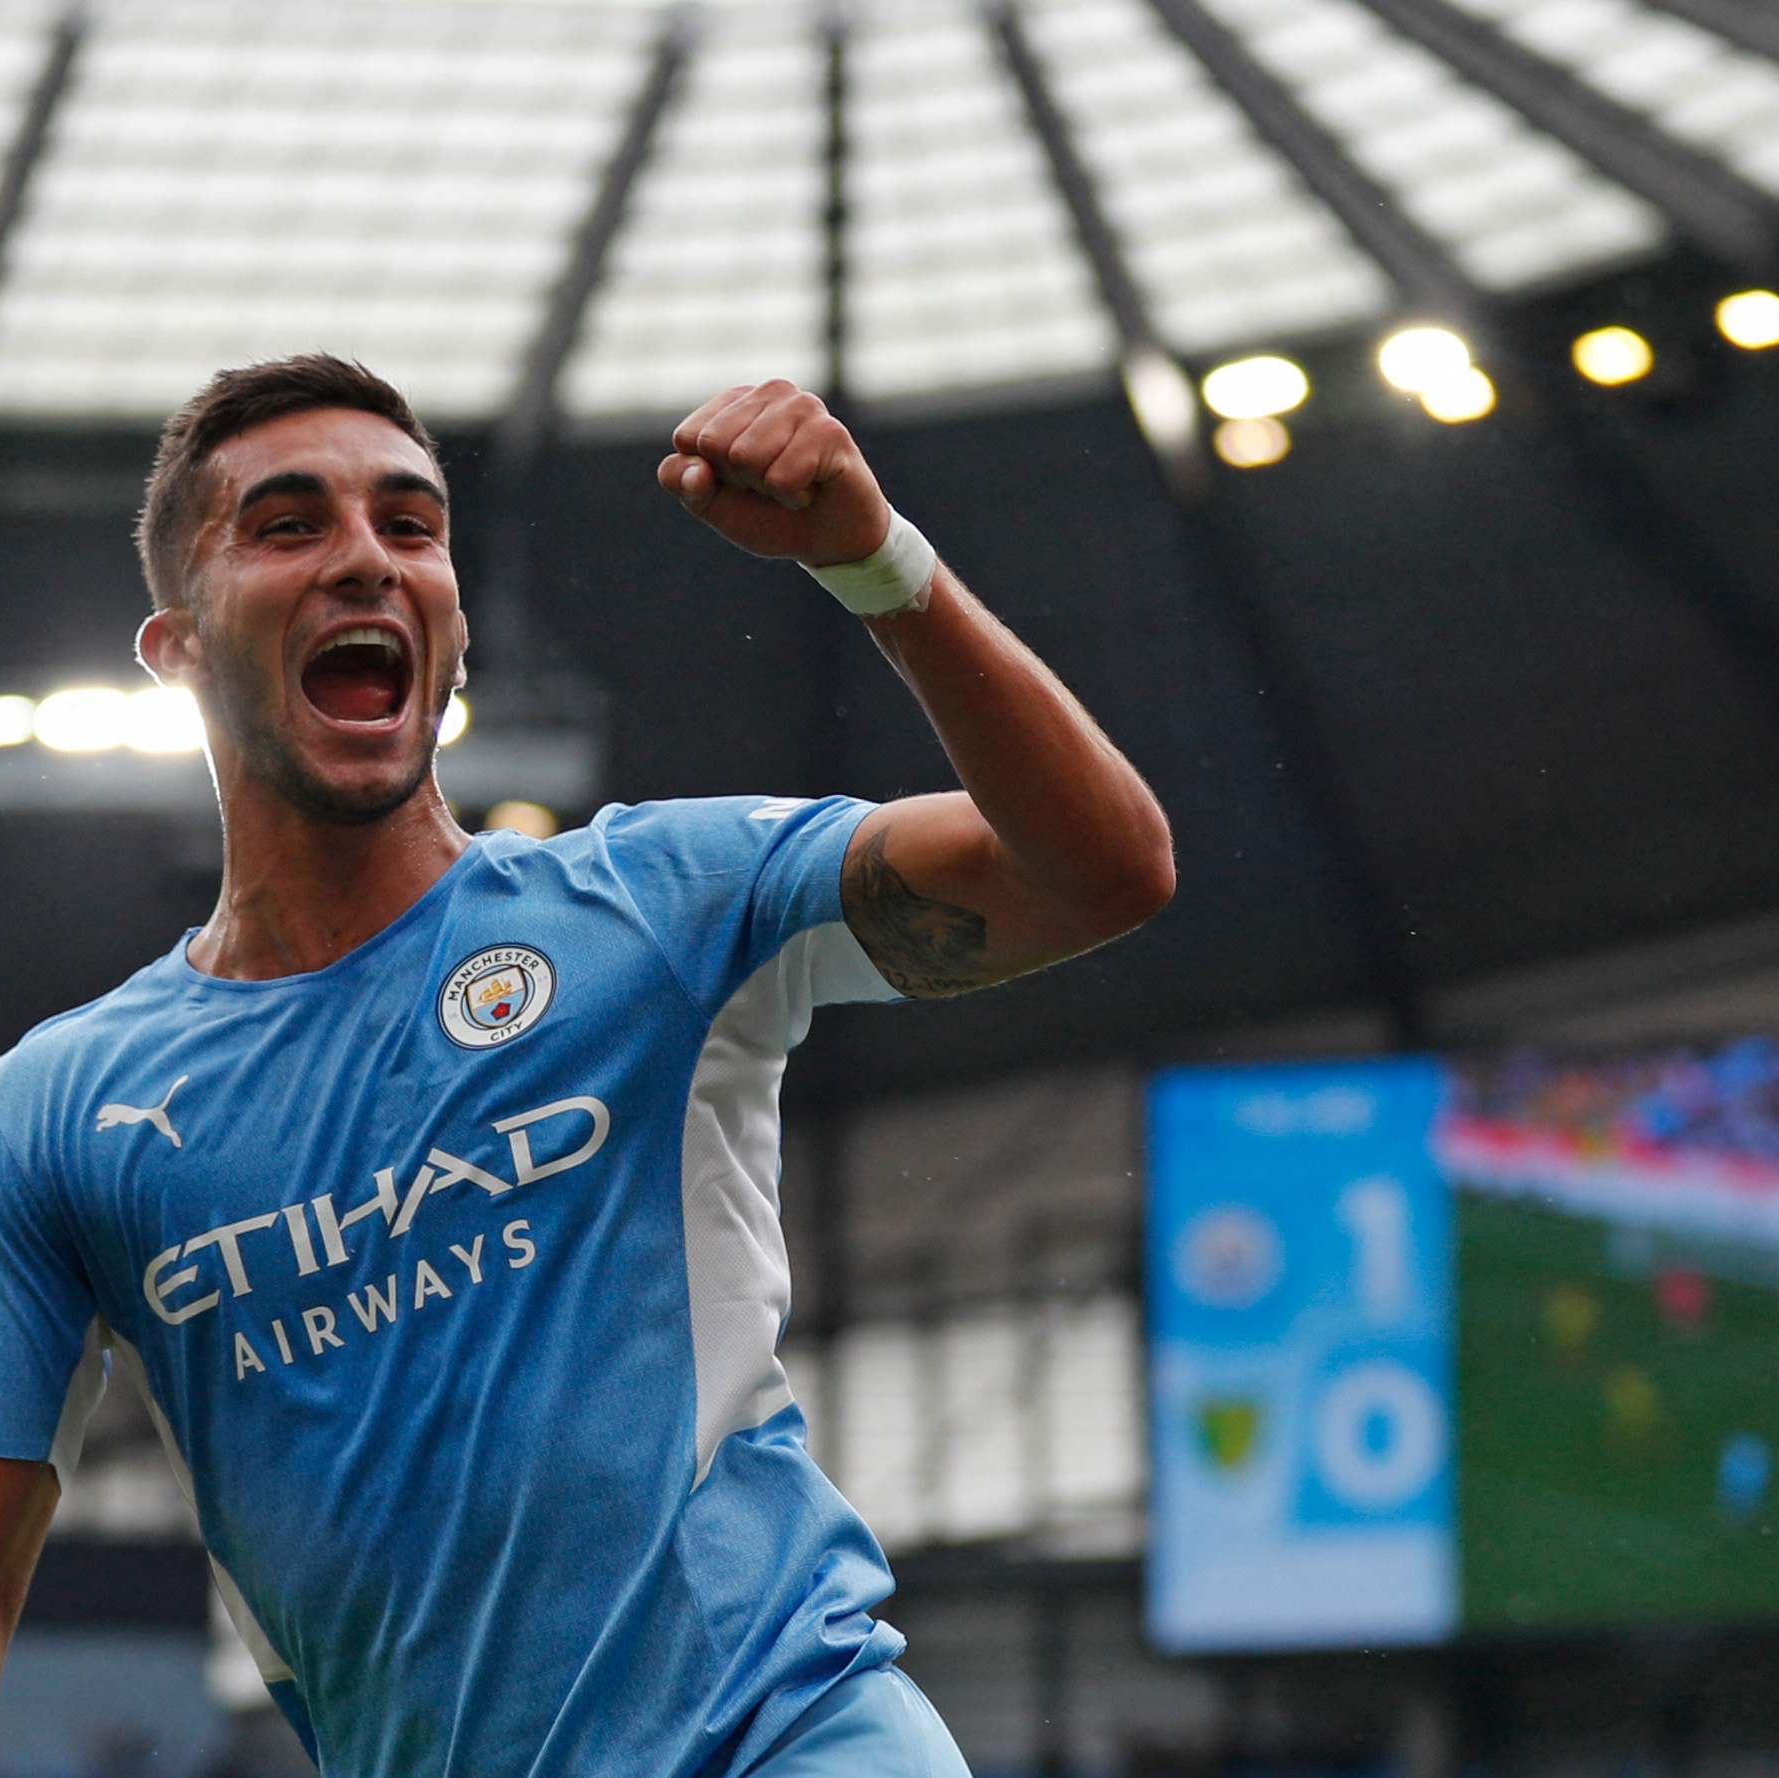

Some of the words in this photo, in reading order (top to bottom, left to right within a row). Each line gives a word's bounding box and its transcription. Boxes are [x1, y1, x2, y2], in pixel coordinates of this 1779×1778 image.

[447, 951, 540, 1001] MANCHESTER
[490, 1020, 523, 1042] CITY
[143, 1095, 611, 1325] ETIHAD
[1338, 1176, 1414, 1325] 1
[235, 1219, 537, 1381] AIRWAYS
[1316, 1363, 1445, 1506] 0
